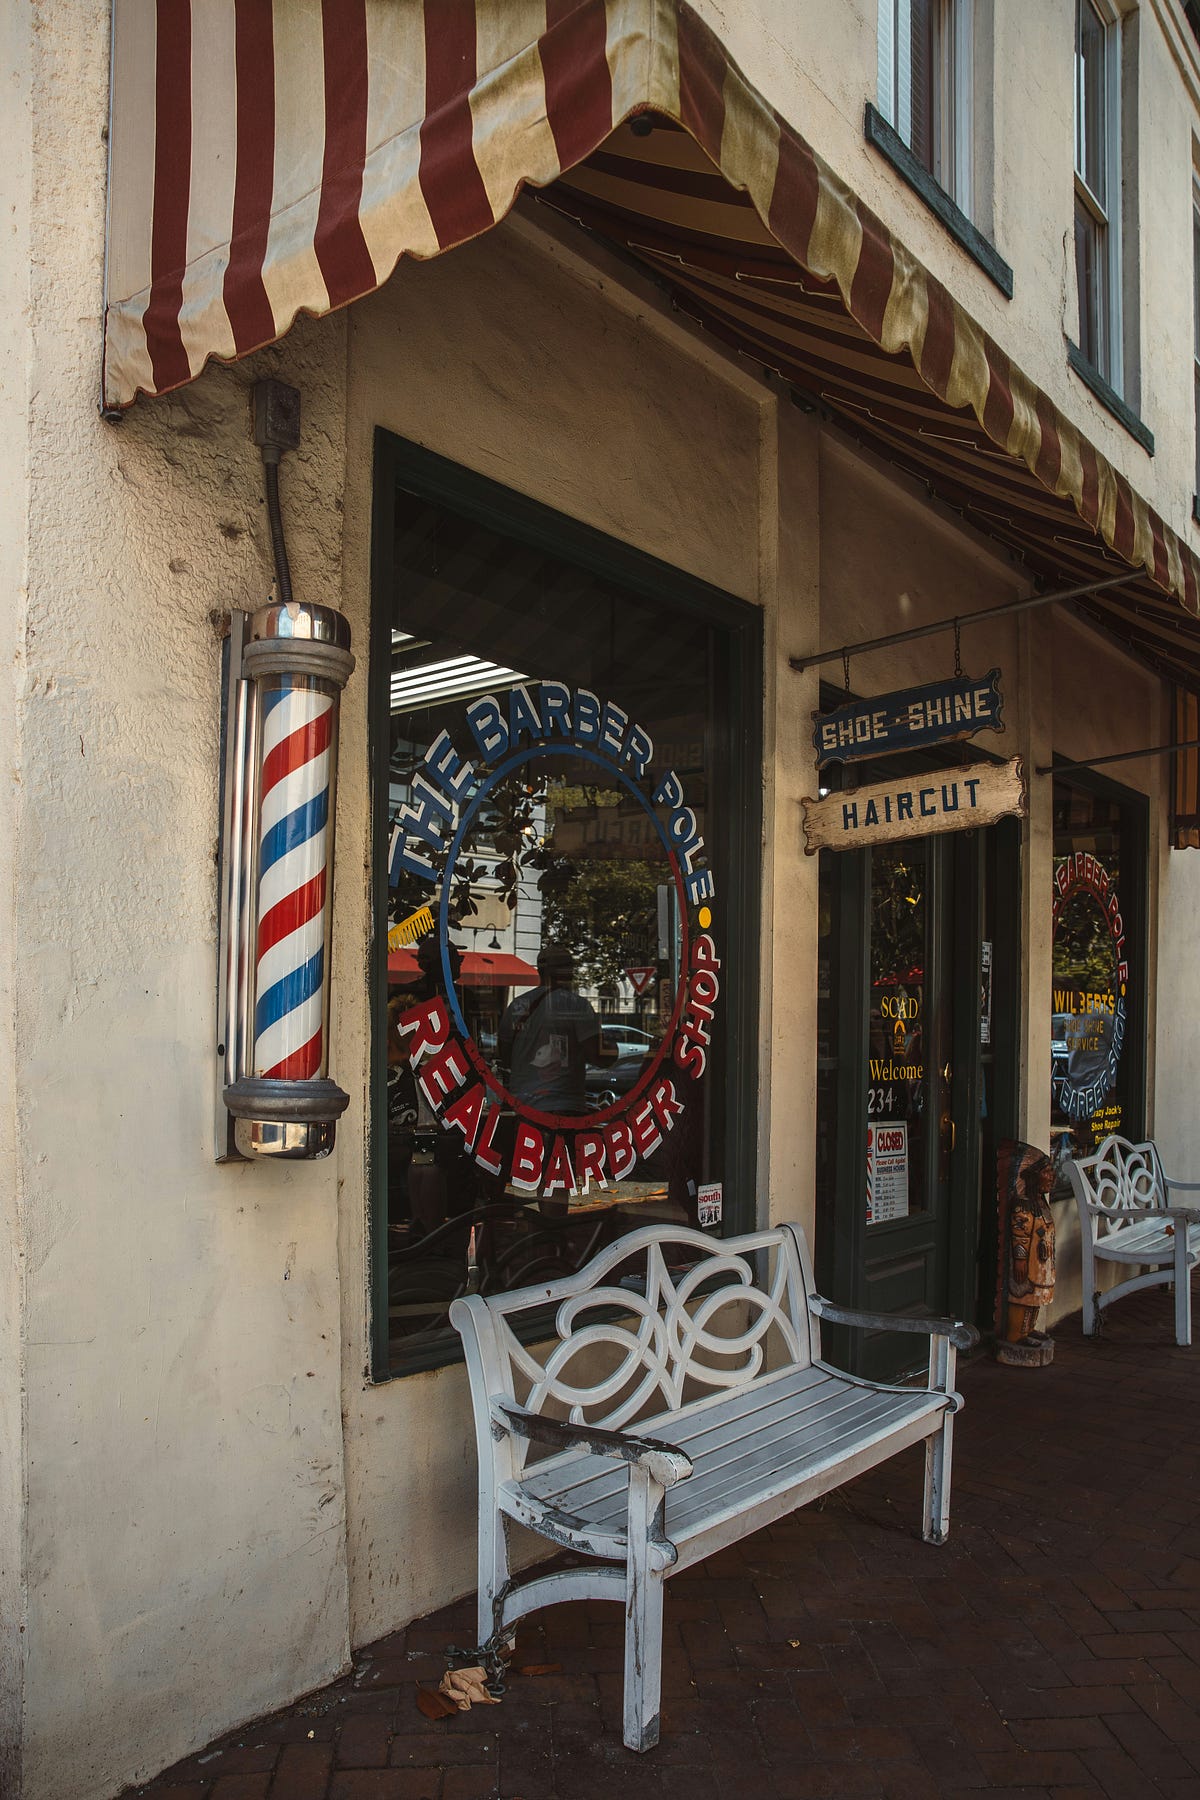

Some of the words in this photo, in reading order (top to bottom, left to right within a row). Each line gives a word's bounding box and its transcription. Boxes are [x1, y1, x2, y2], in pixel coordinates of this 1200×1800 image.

[908, 688, 992, 731] SHINE
[388, 729, 475, 887] THE
[466, 680, 653, 782] BARBER
[651, 770, 716, 906] POLE
[843, 779, 980, 830] HAIRCUT
[1055, 851, 1111, 901] BARBER
[1108, 892, 1129, 981] POLE
[881, 996, 918, 1019] SCAD
[1108, 997, 1128, 1076] SHOP
[397, 995, 502, 1176] REAL
[511, 1078, 685, 1198] BARBER
[672, 933, 722, 1081] SHOP
[869, 1059, 924, 1081] Welcome
[868, 1087, 897, 1114] 234
[878, 1132, 904, 1152] CLOSED
[1091, 1122, 1104, 1132] Shoe
[1104, 1118, 1121, 1130] Repair
[698, 1191, 721, 1204] south
